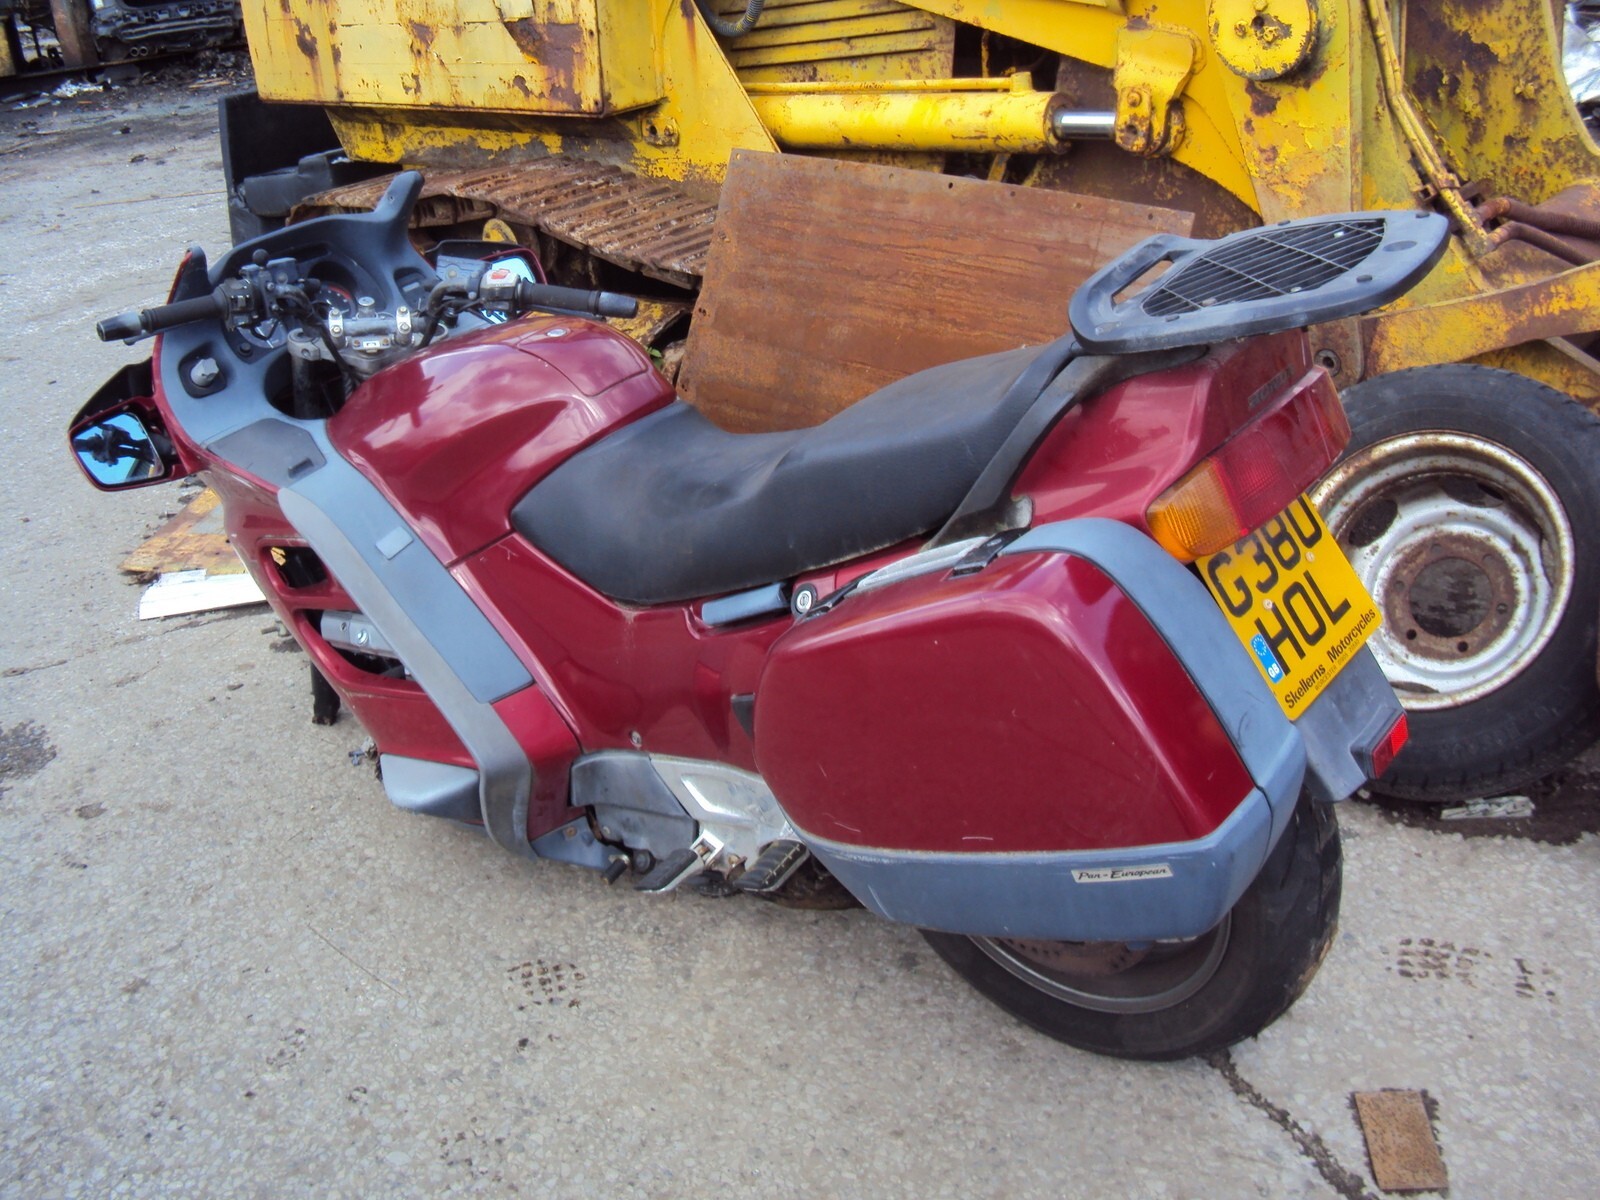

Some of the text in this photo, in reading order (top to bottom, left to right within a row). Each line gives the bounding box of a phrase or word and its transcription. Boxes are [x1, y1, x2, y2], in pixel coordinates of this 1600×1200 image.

[1254, 570, 1352, 676] HOL
[1267, 662, 1280, 679] GB
[1284, 664, 1326, 709] Skellerns
[1326, 609, 1376, 663] Motorcycles
